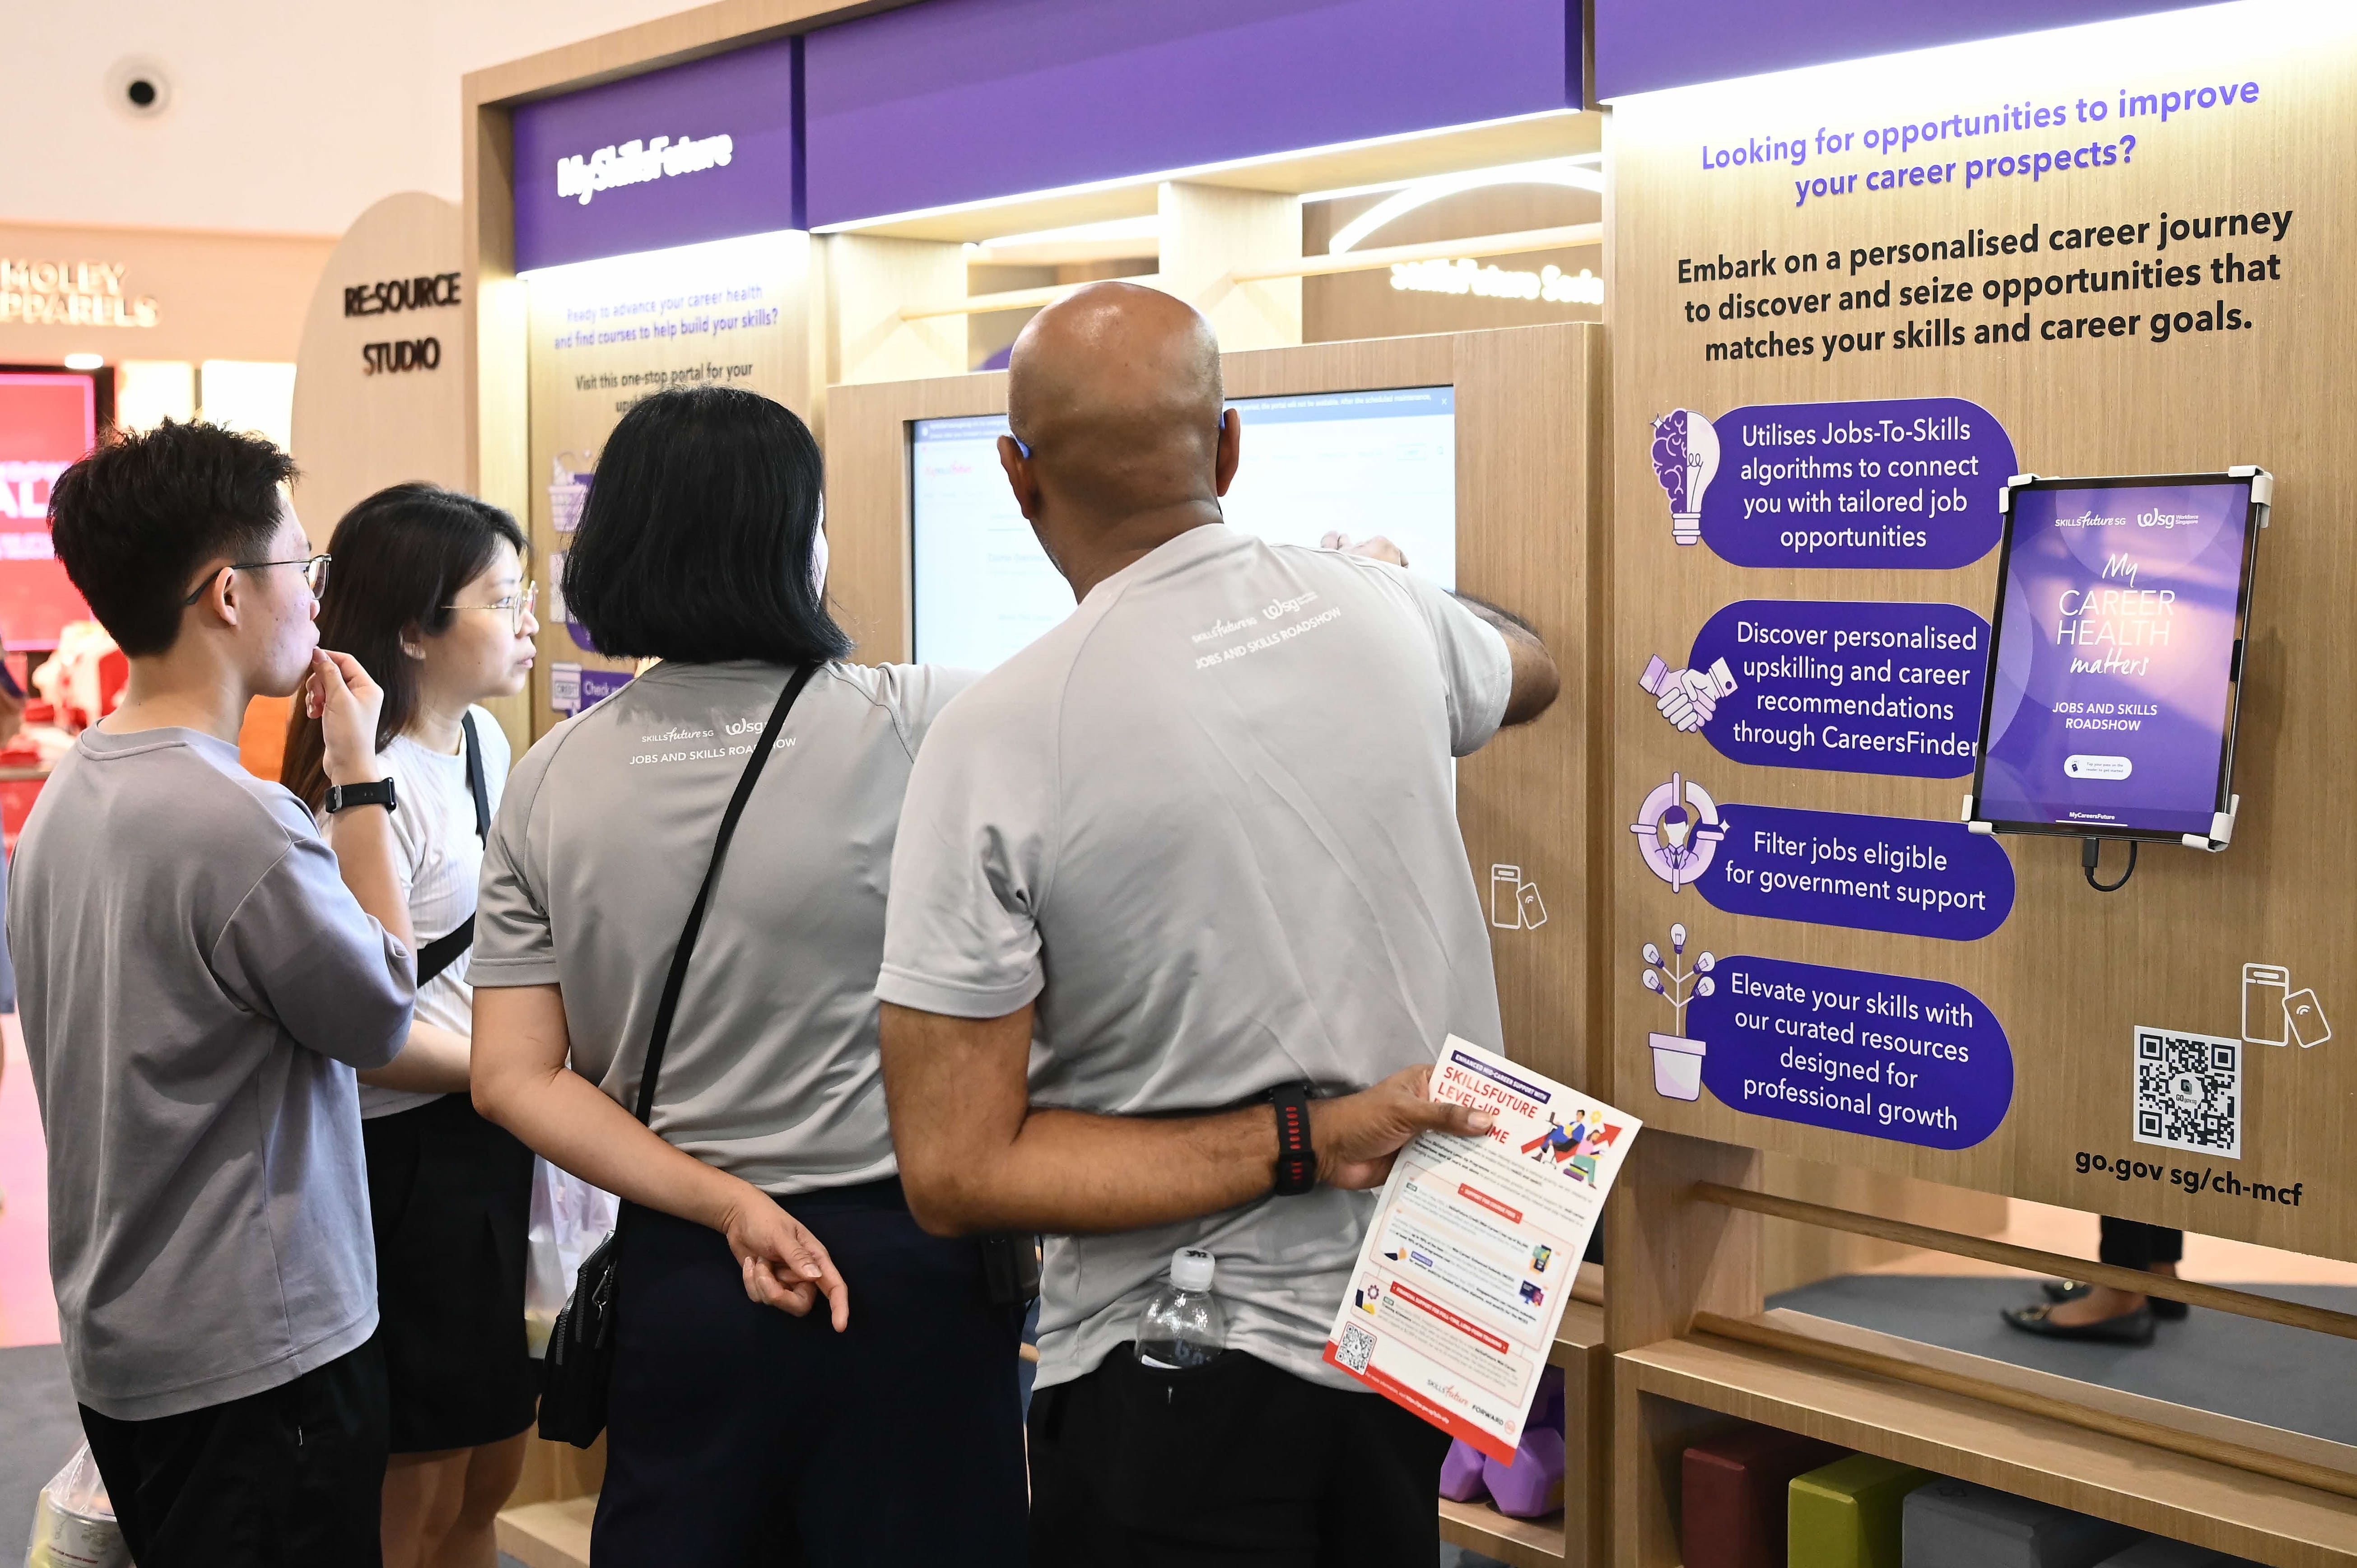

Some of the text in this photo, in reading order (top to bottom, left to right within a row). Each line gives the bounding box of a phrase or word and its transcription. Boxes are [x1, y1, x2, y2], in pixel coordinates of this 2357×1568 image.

[1703, 81, 2259, 169] Looking for opportunities to improve
[1795, 134, 2136, 207] your career prospects?
[1678, 210, 2293, 284] Embark on a personalised career journey
[567, 284, 763, 324] Ready to advance your career health
[1685, 252, 2281, 323] to discover and seize opportunities that
[554, 308, 778, 349] and find courses to help build your skills?
[1706, 300, 2252, 362] matches your skills and career goals.
[363, 337, 441, 376] STUDIO
[576, 361, 753, 390] Visit this one-stop portal for your
[1743, 416, 1970, 447] Utilises Jobs-To-Skills
[1741, 456, 1979, 486] algorithms to connect
[1743, 487, 1967, 519] you with tailored job
[2055, 511, 2114, 528] SKILLSfuture
[2137, 508, 2175, 529] Wsg
[1780, 525, 1926, 553] opportunities
[2102, 553, 2138, 587] My
[1262, 598, 1300, 620] Wsg
[2059, 590, 2176, 617] CAREER
[1196, 607, 1342, 669] JOBS AND SKILLS ROADSHOW
[1737, 621, 1976, 652] Discover personalised
[2056, 620, 2171, 646] HEALTH
[1744, 655, 1970, 687] upskilling and career
[2069, 648, 2150, 676] matters
[585, 681, 610, 696] Check
[1757, 693, 1953, 720] recommendations
[2052, 702, 2157, 716] JOBS AND SKILLS
[642, 718, 763, 742] SKILLSfuture SG Wsg
[1733, 722, 1977, 758] through CareersFinder
[2065, 717, 2141, 732] ROADSHOW
[630, 737, 797, 765] JOBS AND SKILLS ROAOW
[1755, 831, 1947, 873] Filter jobs eligible
[1725, 861, 1986, 912] for government support
[1732, 972, 1972, 1028] Elevate your skills with
[1735, 1012, 1969, 1062] our curated resources
[1780, 1046, 1918, 1089] designed for
[1437, 1081, 1500, 1120] LEVEL-UP
[1444, 1065, 1538, 1118] SKILLSFUTURE
[1744, 1078, 1957, 1131] professional growth
[2175, 1093, 2197, 1105] GO.gov.sg
[2076, 1151, 2303, 1206] go.gov sg/ch-mcf
[1426, 1373, 1471, 1407] SKILLSfuture
[1472, 1404, 1504, 1426] FORWARD
